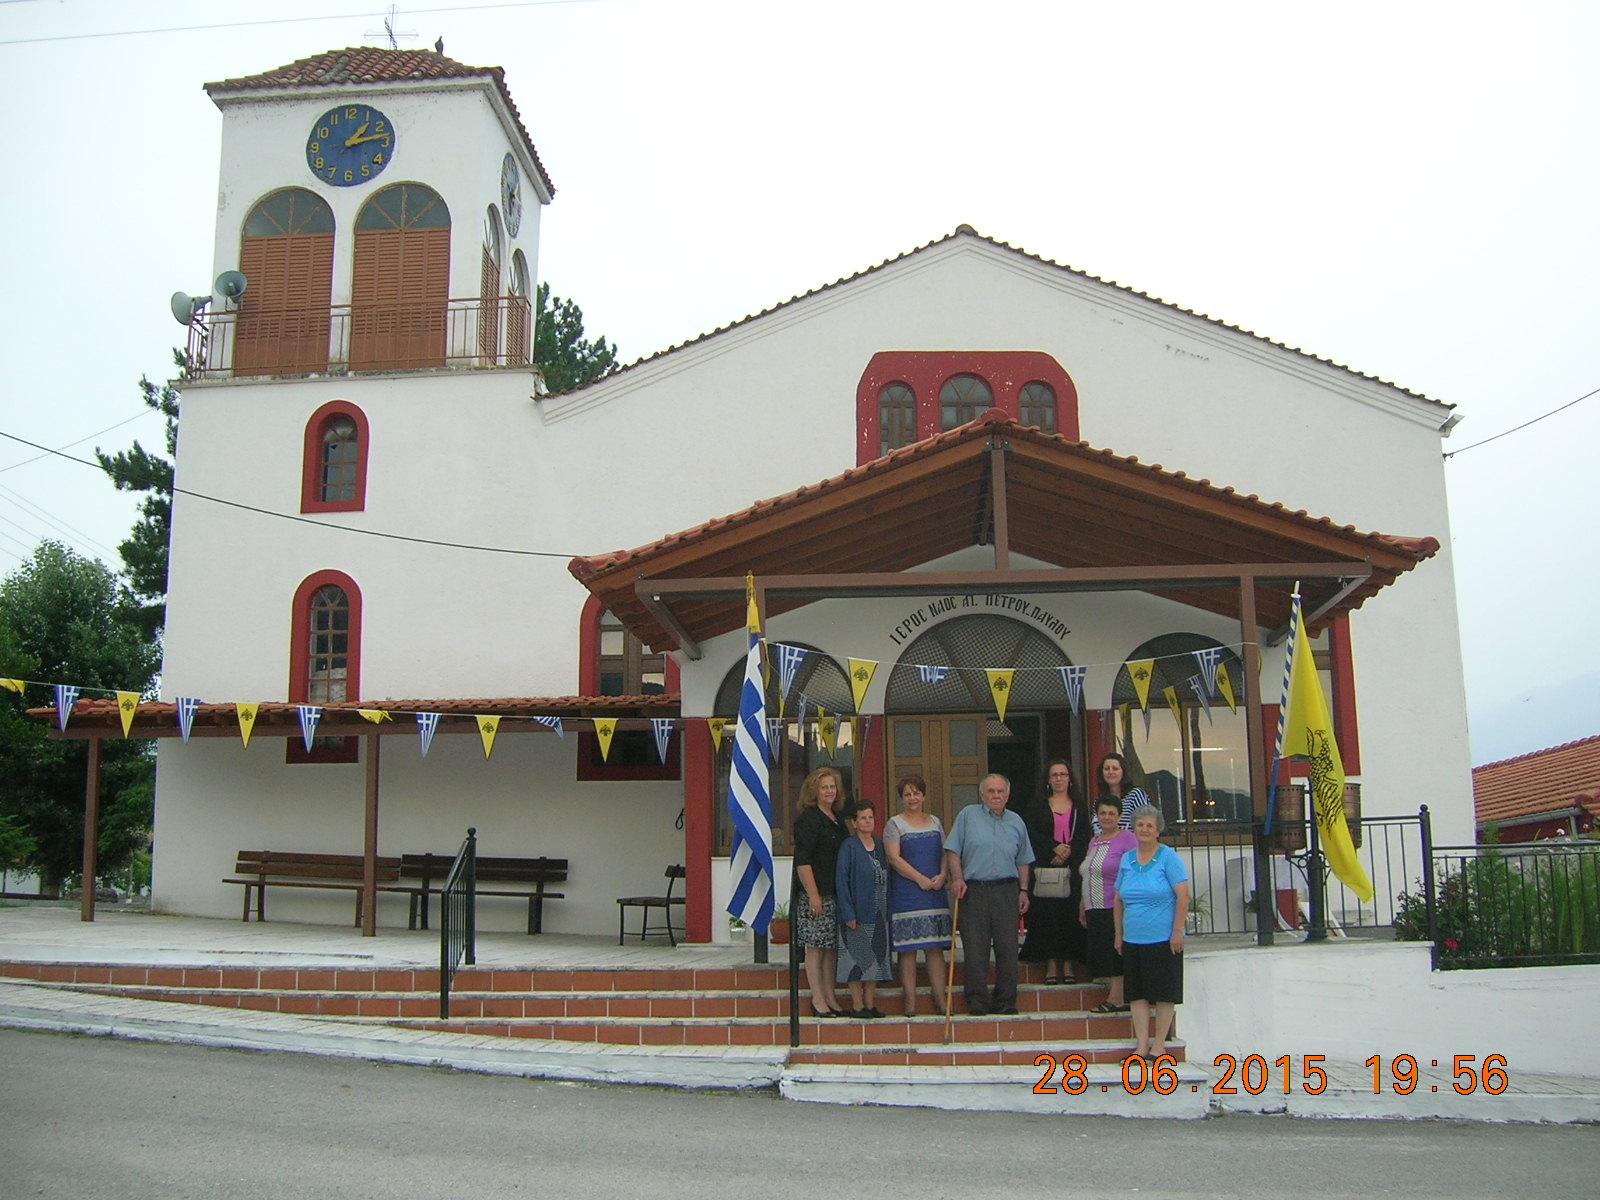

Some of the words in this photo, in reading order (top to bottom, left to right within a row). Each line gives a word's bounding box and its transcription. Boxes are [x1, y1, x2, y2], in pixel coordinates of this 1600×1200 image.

[330, 114, 338, 125] 11
[345, 108, 357, 120] 12
[365, 111, 370, 121] 1
[375, 121, 384, 132] 2
[317, 127, 329, 138] 10
[381, 136, 390, 147] 3
[311, 142, 319, 153] 9
[315, 157, 324, 169] 8
[373, 152, 383, 164] 4
[328, 167, 337, 179] 7
[344, 170, 353, 182] 6
[361, 165, 370, 177] 5
